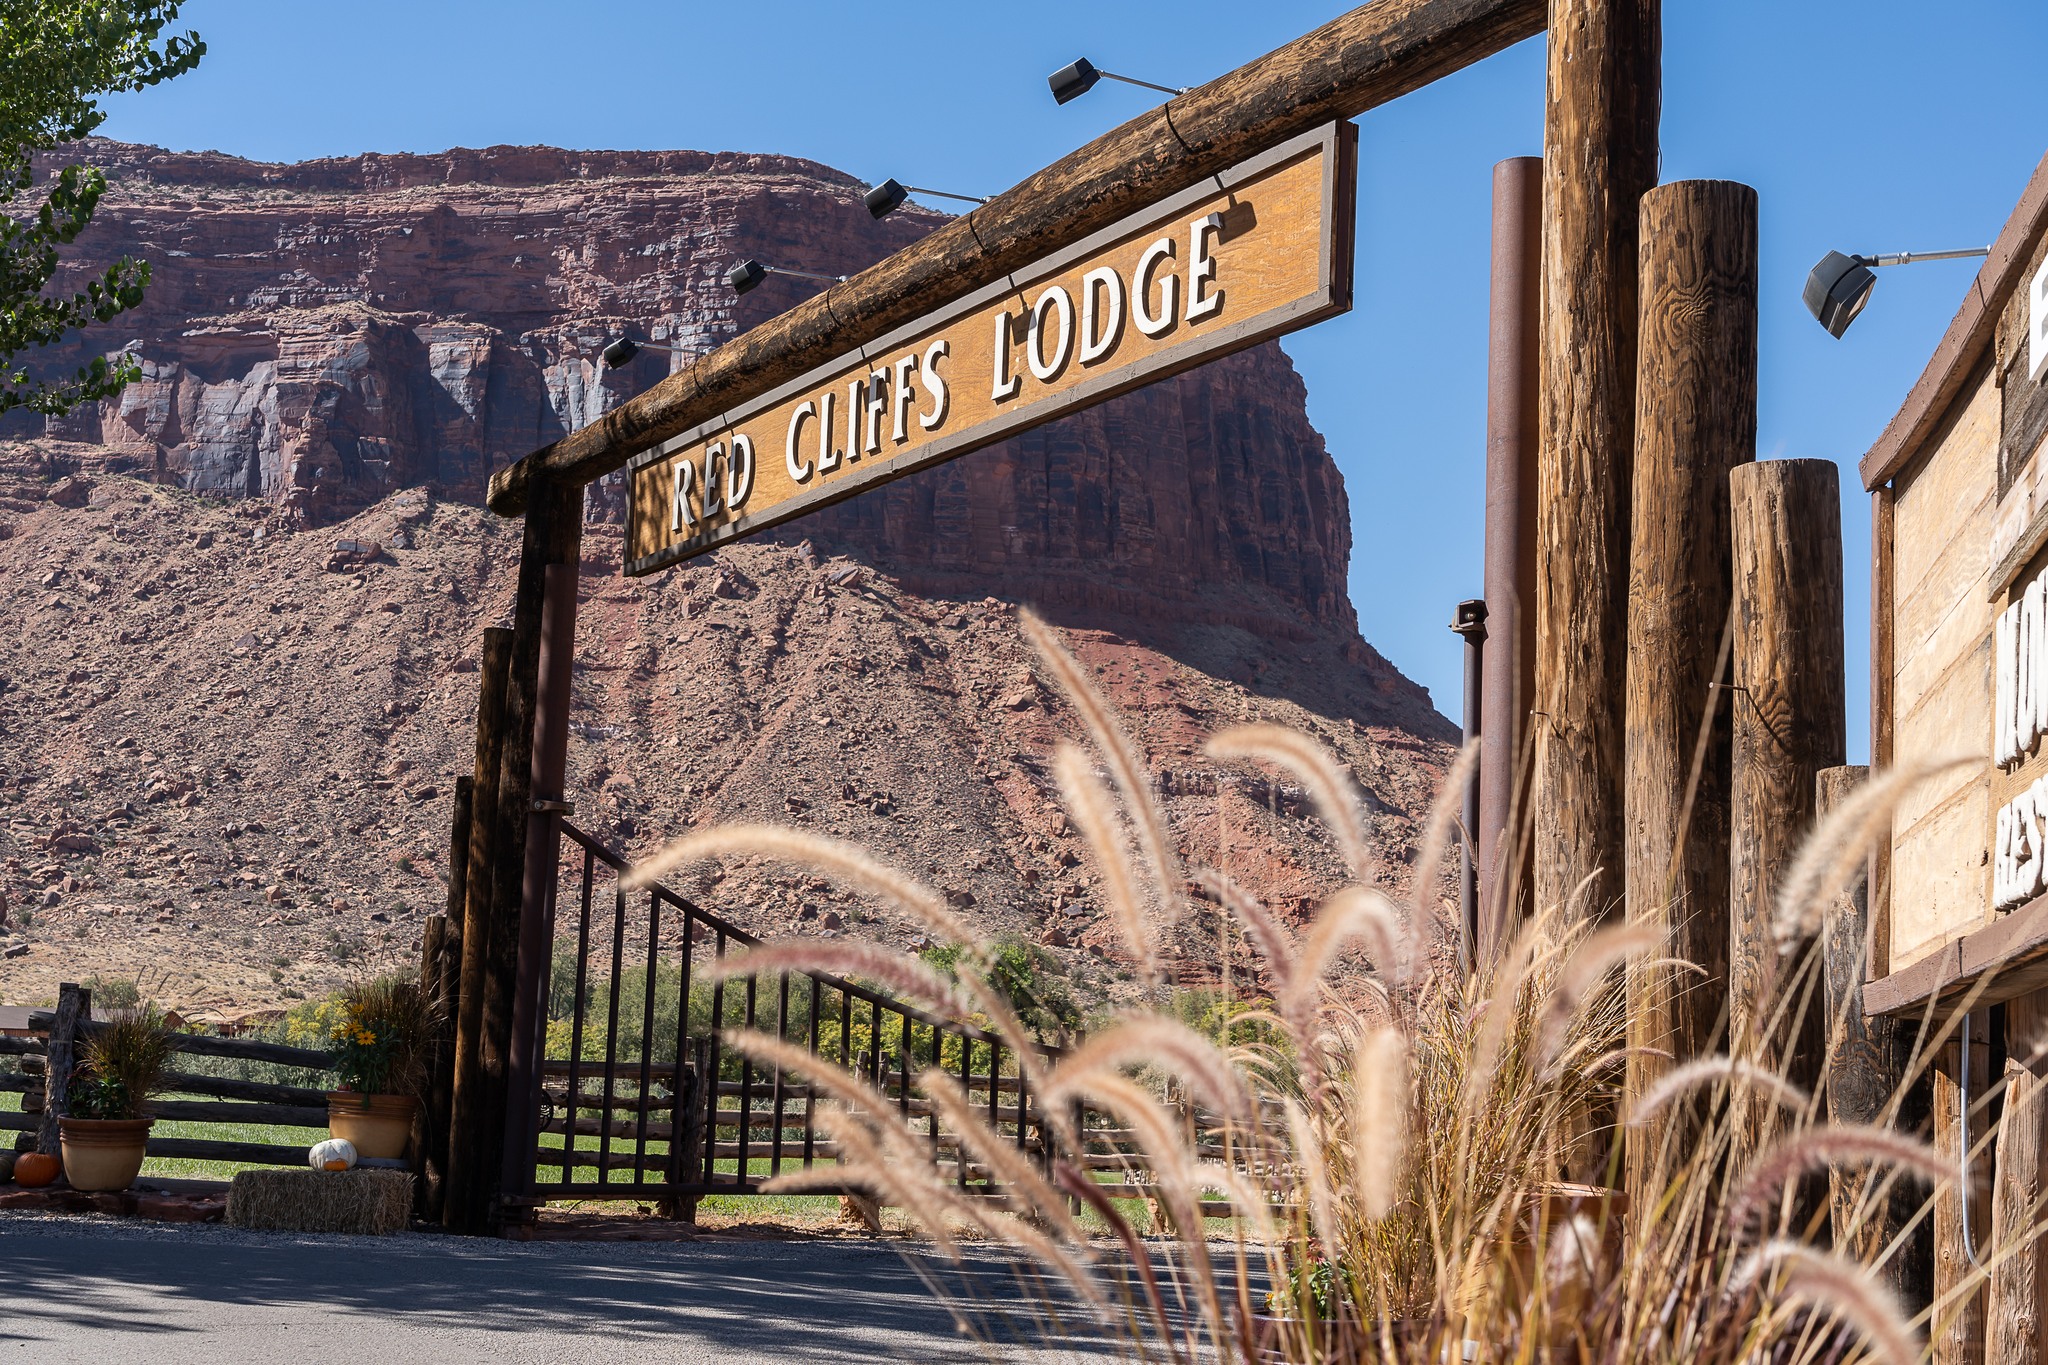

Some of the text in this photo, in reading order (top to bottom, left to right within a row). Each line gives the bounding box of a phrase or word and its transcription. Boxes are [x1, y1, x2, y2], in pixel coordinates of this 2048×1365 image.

[671, 211, 1224, 532] RED CLIFFS LODGE
